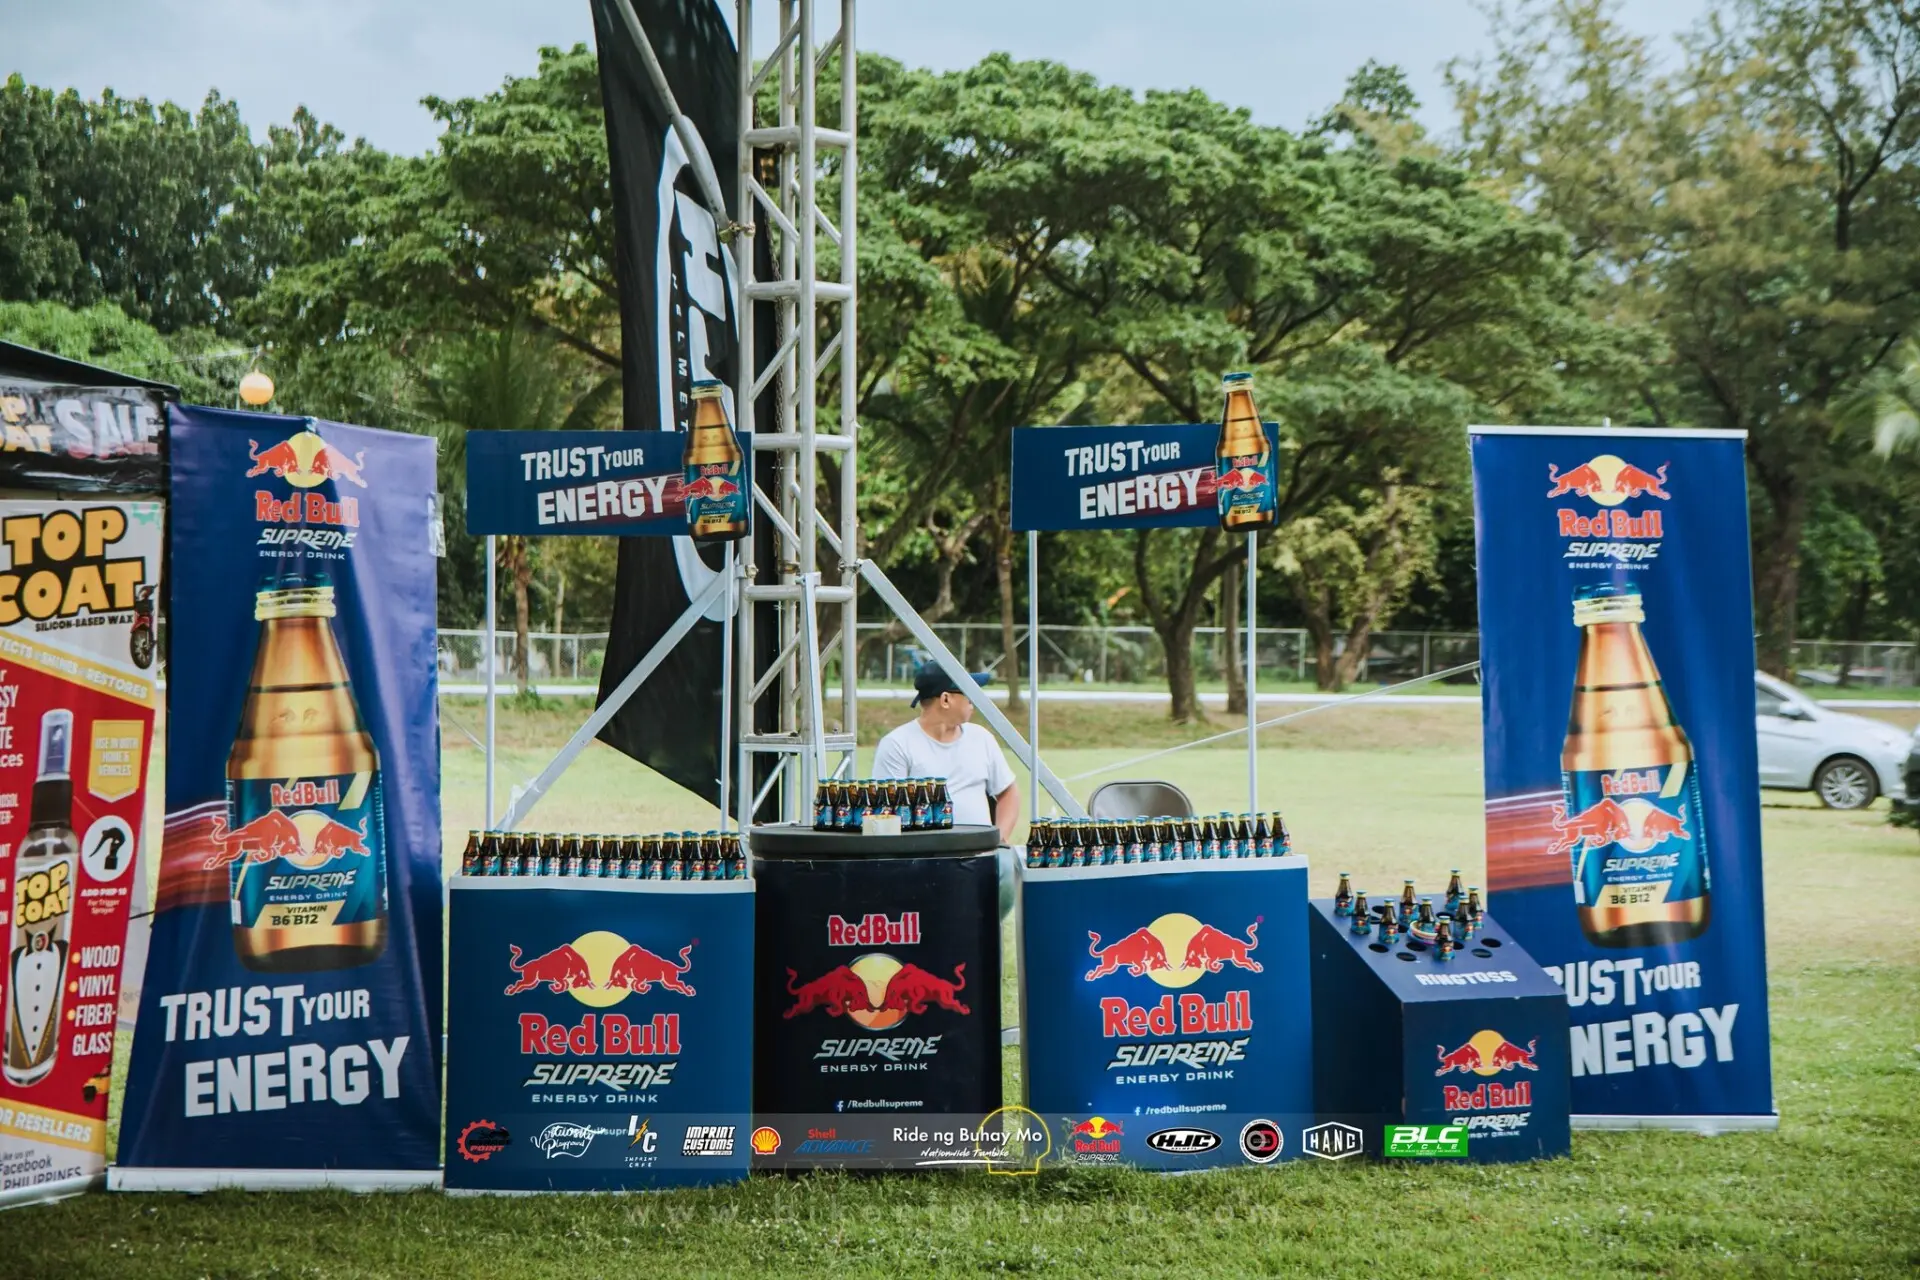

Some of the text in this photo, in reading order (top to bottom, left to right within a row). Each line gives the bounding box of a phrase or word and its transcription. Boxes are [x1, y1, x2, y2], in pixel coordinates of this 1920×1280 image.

[671, 273, 692, 433] HELMET
[520, 446, 644, 481] TRUST YOUR
[1064, 440, 1180, 477] TRUST YOUR
[537, 475, 668, 525] ENERGY
[1079, 468, 1202, 520] ENERGY
[255, 490, 359, 527] Red Bull
[4, 506, 127, 566] TOP
[1557, 508, 1664, 538] Red Bull
[256, 528, 358, 550] SUPREME
[1563, 542, 1662, 561] SUPREME
[259, 550, 345, 560] ENERGY DRINK
[1568, 562, 1612, 570] ENERGY
[0, 558, 145, 626] COAT
[1602, 852, 1680, 873] SUPREME
[16, 861, 70, 902] TOP
[265, 870, 357, 891] SUPREME
[269, 891, 348, 902] ENERGY DRINK
[286, 904, 328, 914] VITAMIN
[271, 914, 318, 926] B6 B12
[81, 945, 120, 968] WOOD
[78, 974, 116, 998] VINYL
[1639, 961, 1701, 996] YOUR
[74, 1002, 117, 1027] FIBER-
[160, 984, 370, 1042] TRUST YOUR
[1100, 990, 1253, 1038] Red Bull
[72, 1032, 112, 1056] GLASS
[518, 1013, 682, 1056] Red Bull
[813, 1034, 943, 1061] SUPREME
[1569, 1003, 1740, 1077] NERGY
[820, 1063, 928, 1073] ENERGY DRINK
[1106, 1037, 1250, 1071] SUPREME
[185, 1036, 410, 1118] ENERGY
[523, 1062, 678, 1092] SUPREME
[1116, 1070, 1235, 1085] ENERGY DRINK
[532, 1094, 658, 1103] ENERGY DRINK
[847, 1099, 924, 1110] /Redbullsupreme
[1145, 1104, 1227, 1115] /redbullsupreme
[1443, 1081, 1532, 1111] Red Bull
[15, 1111, 92, 1143] RESELLERS
[1452, 1112, 1532, 1132] SUPREME
